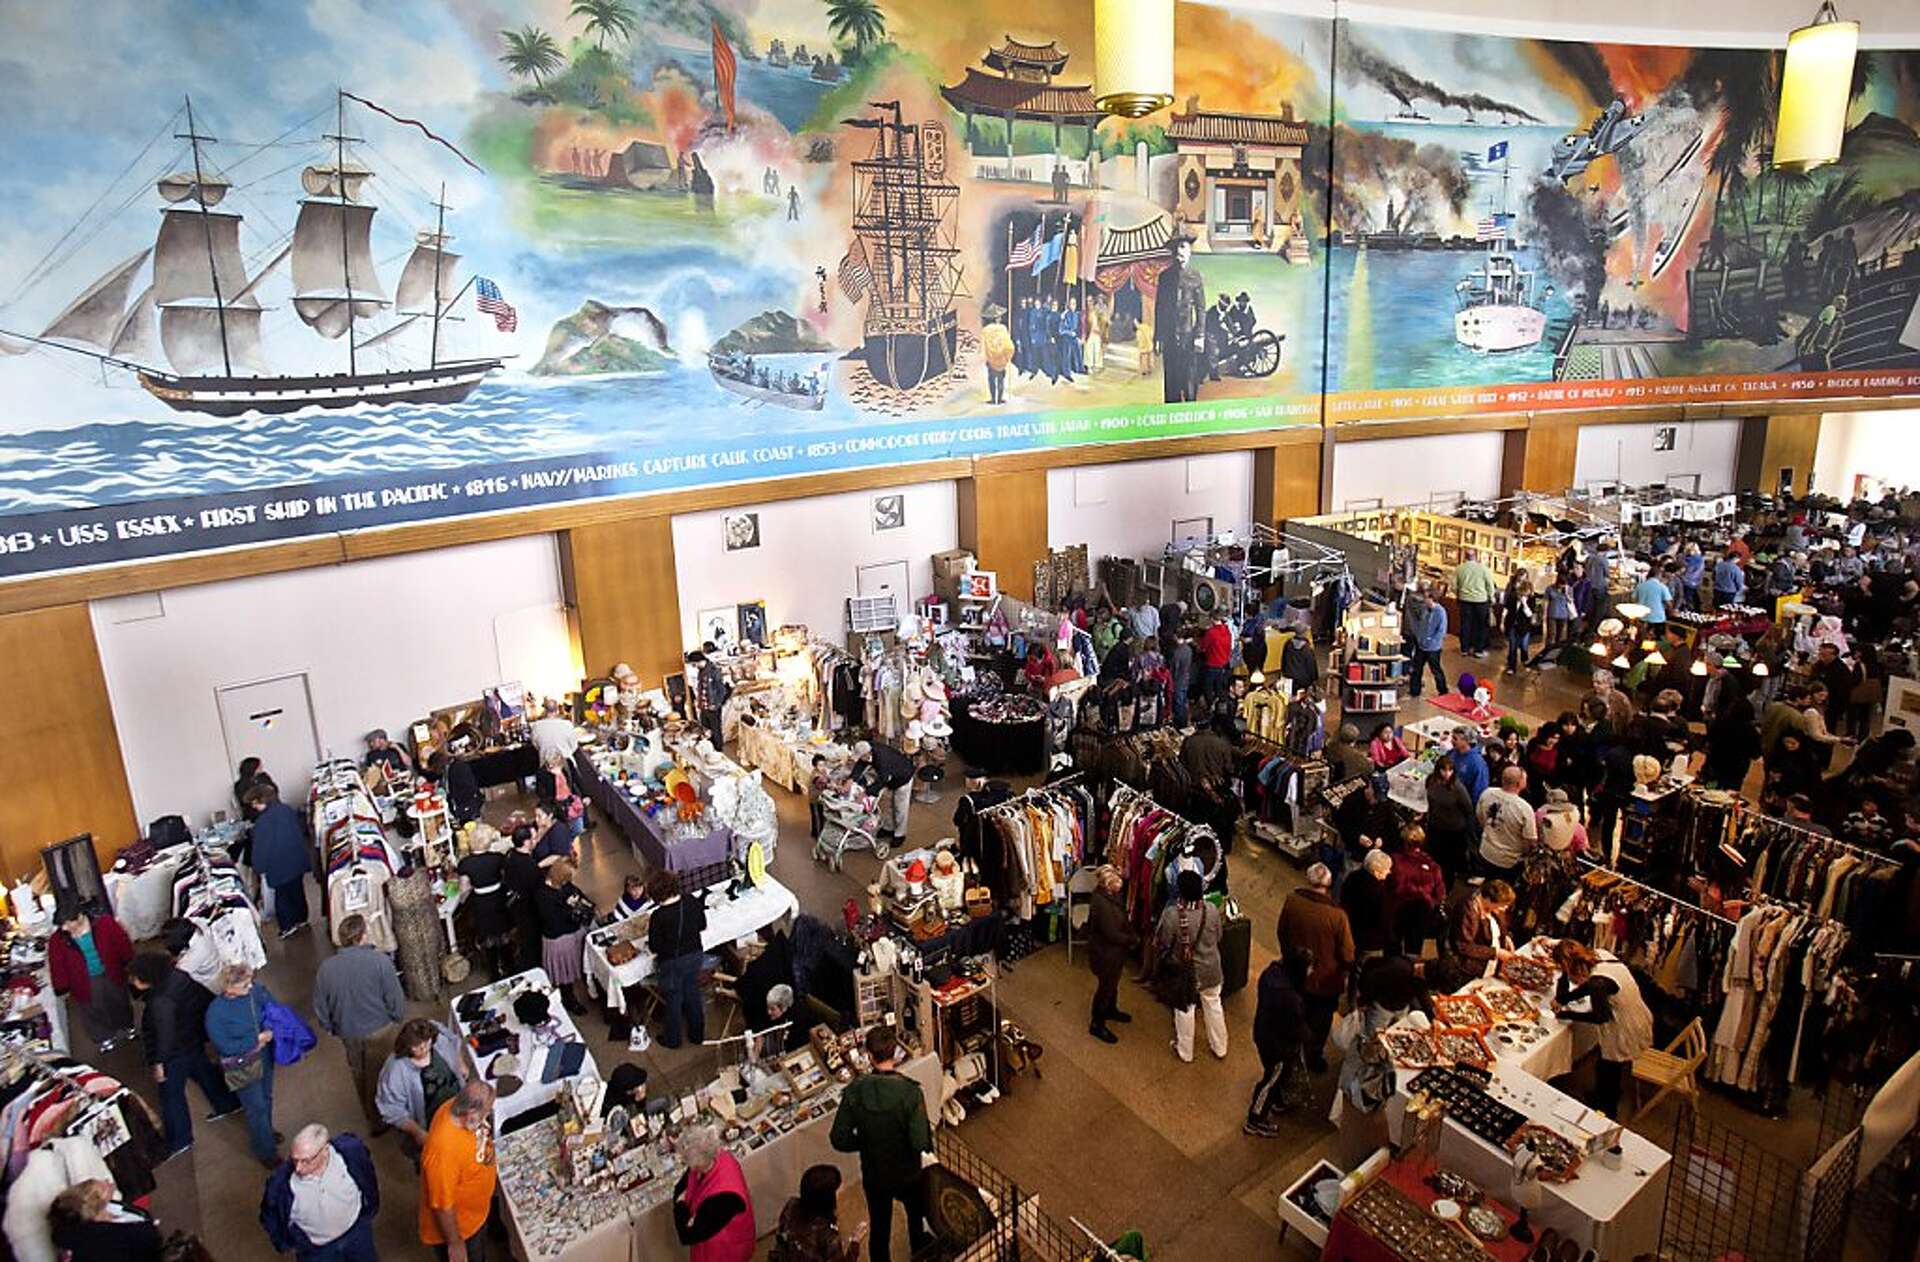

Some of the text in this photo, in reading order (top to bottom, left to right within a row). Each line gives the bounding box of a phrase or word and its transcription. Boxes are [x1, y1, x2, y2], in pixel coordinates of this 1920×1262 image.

[57, 523, 109, 546] USS
[115, 515, 183, 539] ESSEX
[200, 504, 258, 529] FIRST
[264, 500, 309, 521] SHIP
[316, 497, 338, 515] IN
[341, 491, 377, 511] THE
[381, 482, 448, 506] PACIFIC
[643, 453, 707, 476] CAPTURE
[752, 445, 795, 464] COAST
